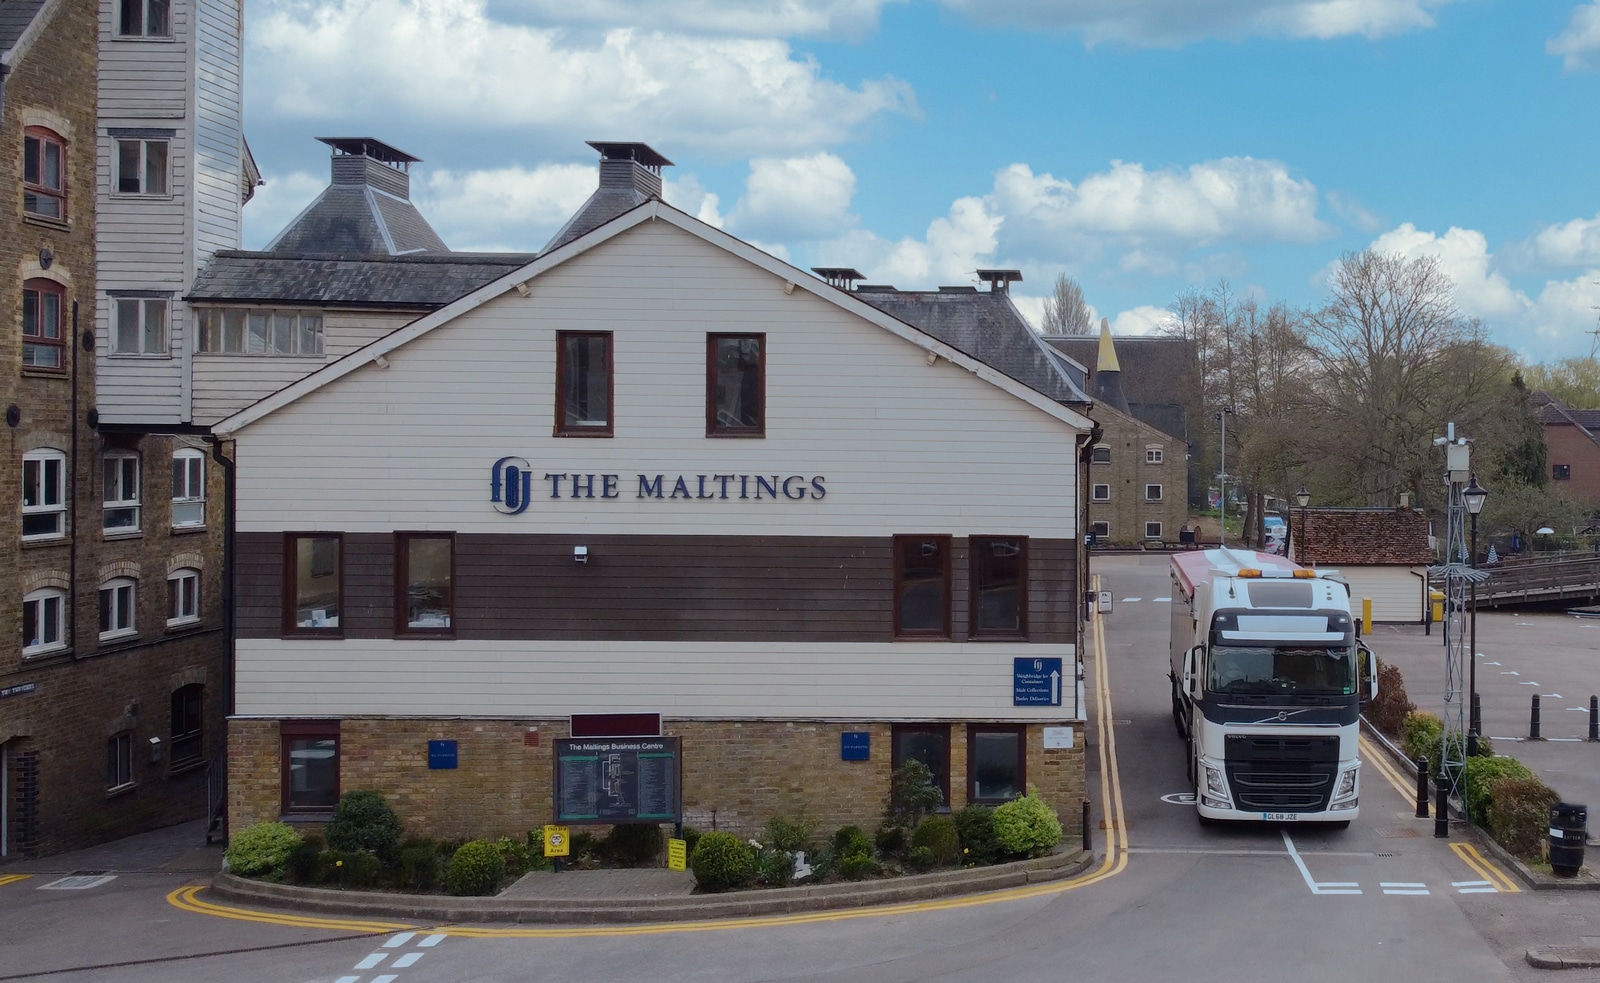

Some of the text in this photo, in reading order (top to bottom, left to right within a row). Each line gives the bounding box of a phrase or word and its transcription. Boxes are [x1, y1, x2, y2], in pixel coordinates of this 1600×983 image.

[544, 473, 826, 500] THE MALTINGS
[583, 743, 610, 751] Maltings
[611, 742, 641, 750] Business
